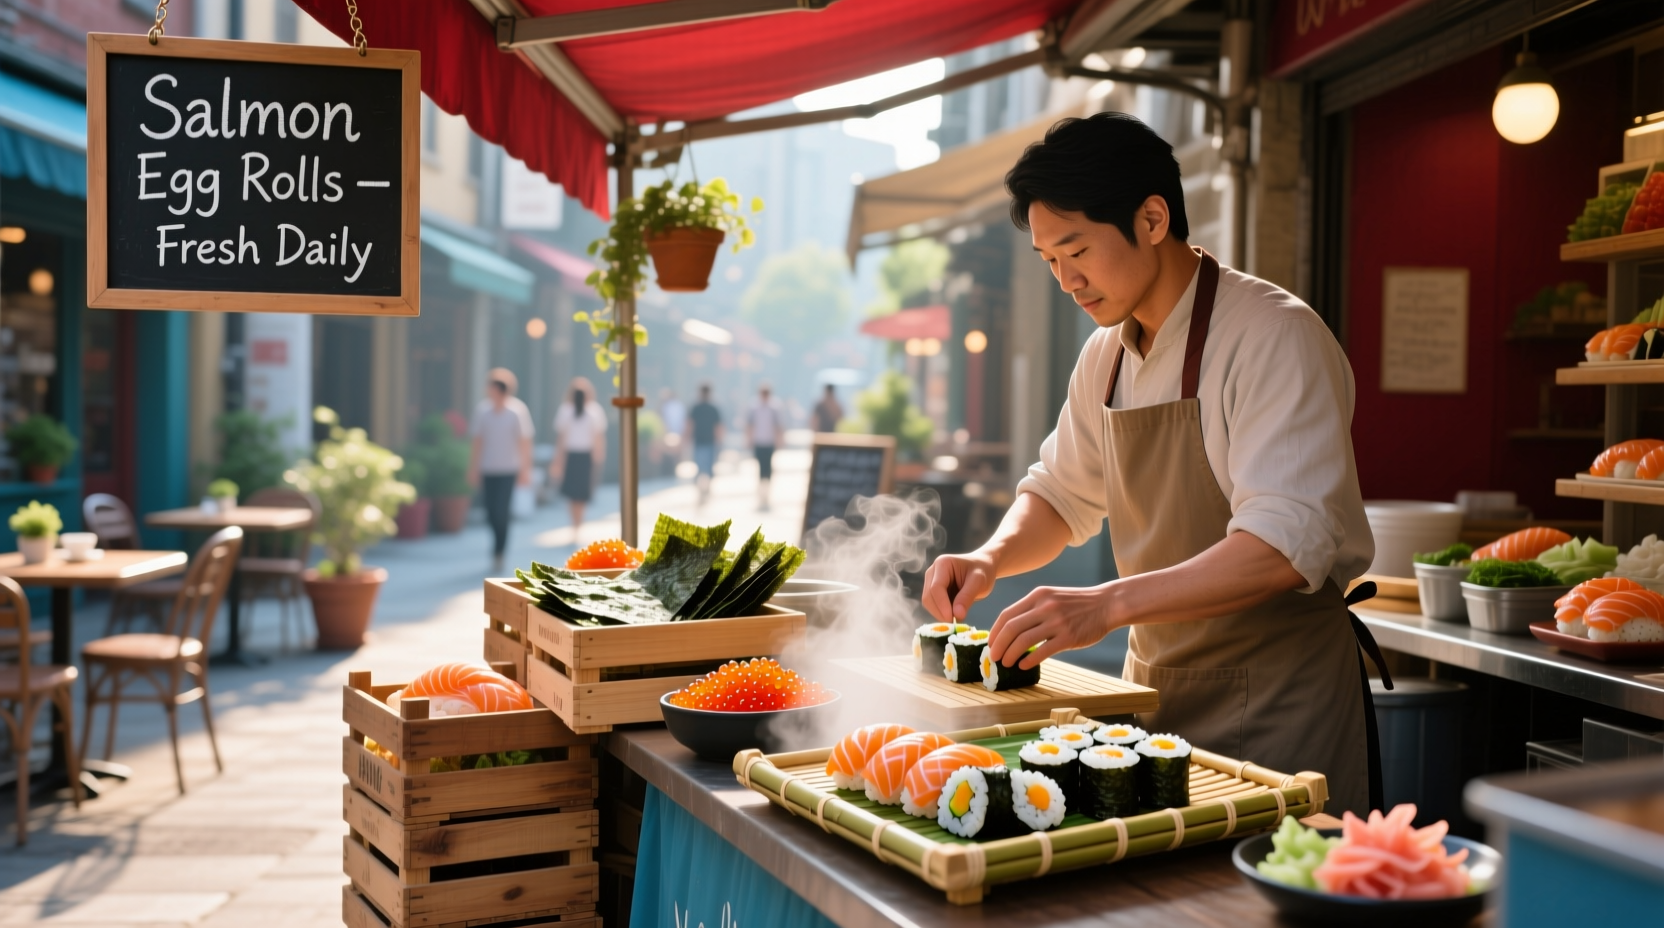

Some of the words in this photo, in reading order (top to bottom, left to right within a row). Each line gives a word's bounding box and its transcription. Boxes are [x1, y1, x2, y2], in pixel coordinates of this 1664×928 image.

[139, 73, 361, 143] Salmon
[137, 151, 220, 218] Egg
[240, 151, 344, 203] Rolls
[156, 223, 261, 267] Fresh
[275, 223, 373, 284] Daily
